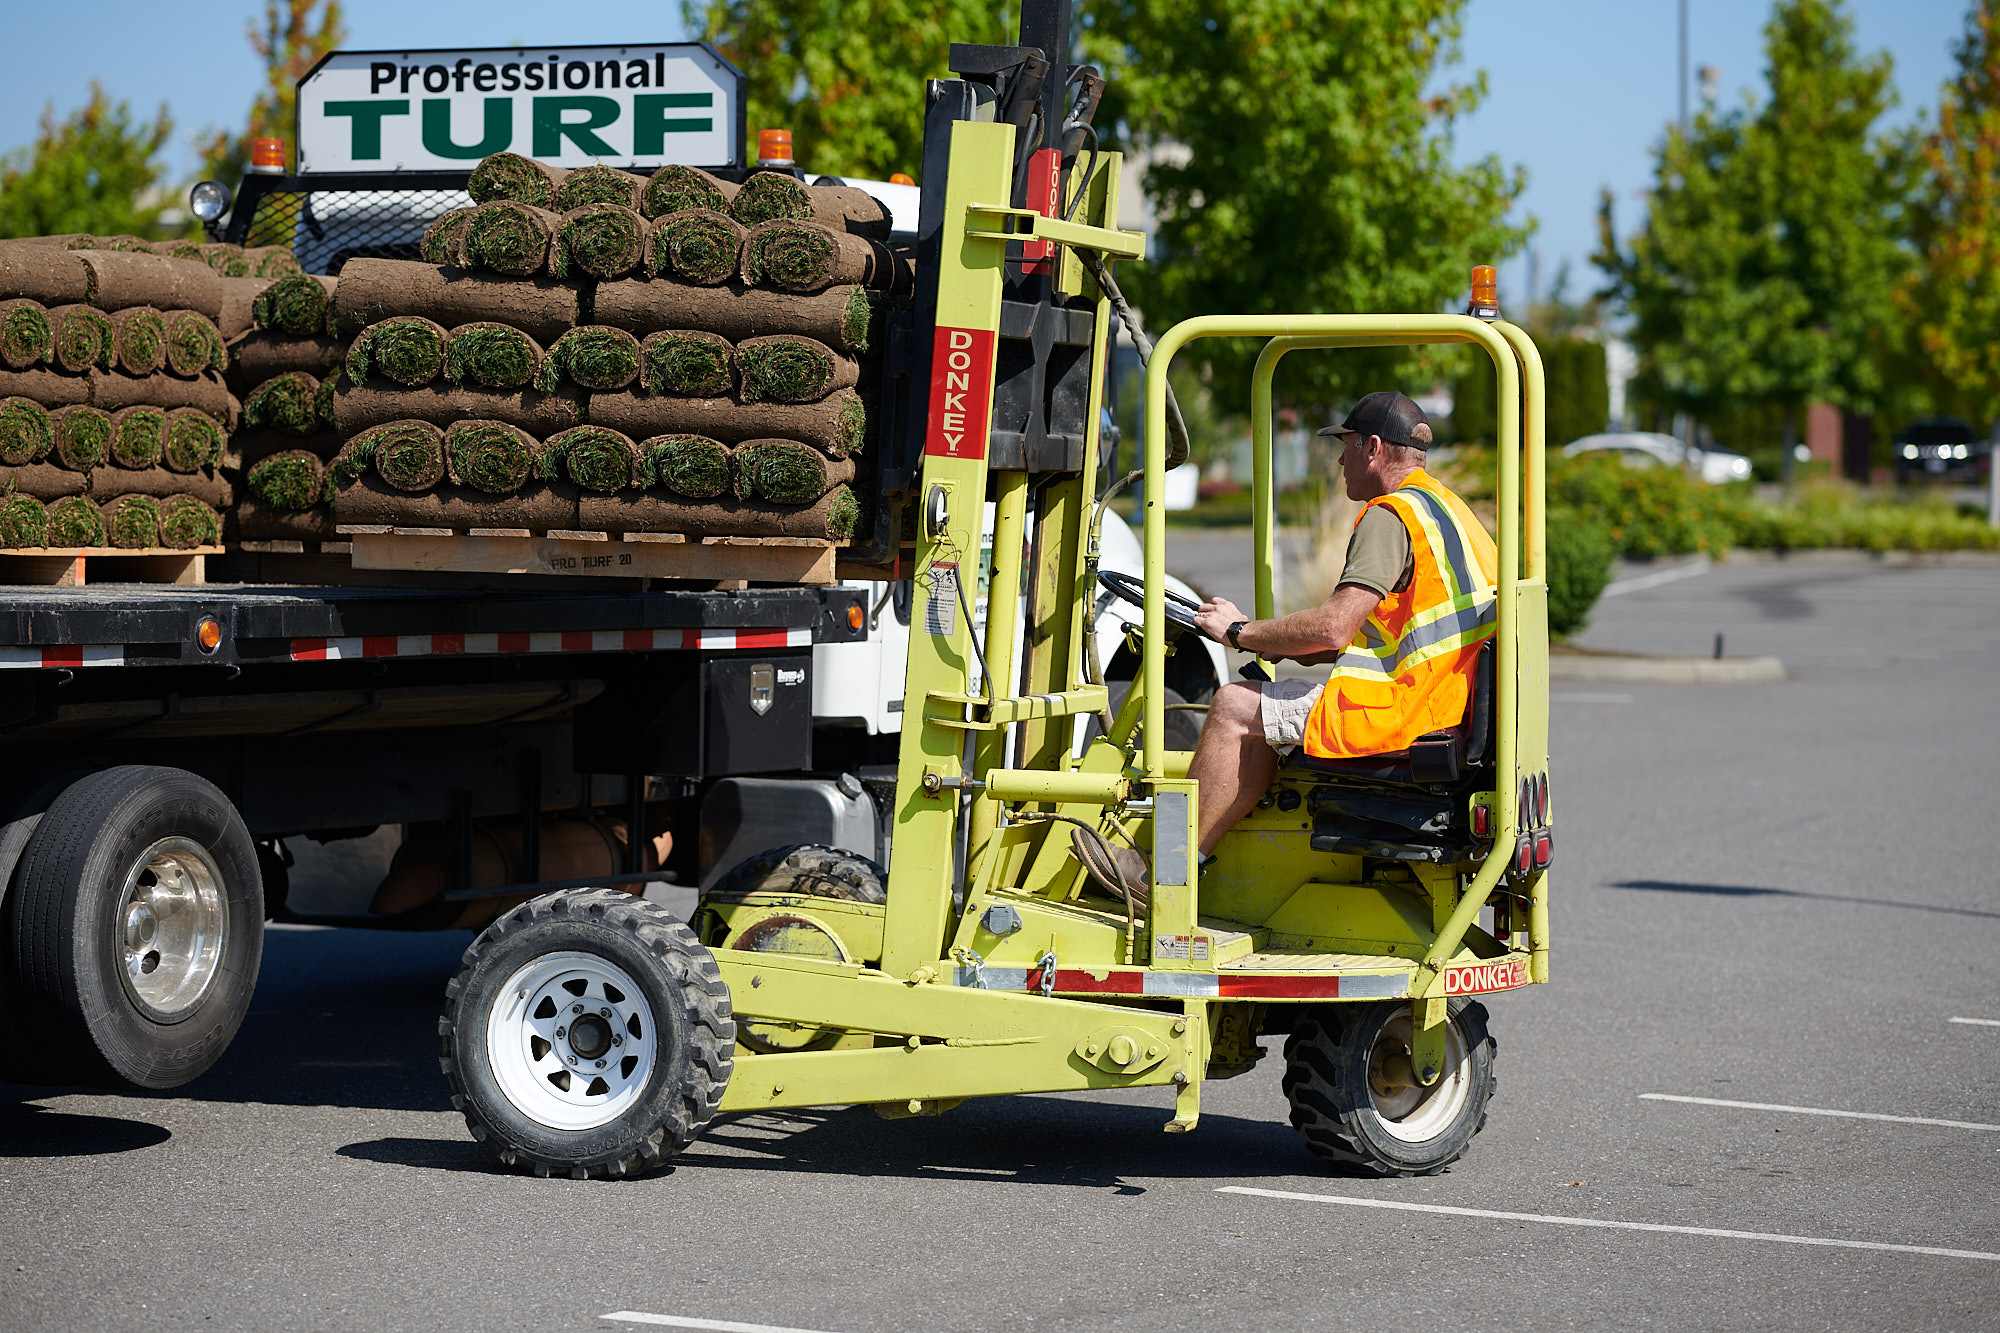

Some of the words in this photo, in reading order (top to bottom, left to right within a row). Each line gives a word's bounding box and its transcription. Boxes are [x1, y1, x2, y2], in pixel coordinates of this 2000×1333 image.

[370, 52, 666, 94] Professional
[323, 92, 714, 161] TURF
[1048, 152, 1060, 220] LOOK
[942, 330, 974, 452] DONKEY
[551, 557, 577, 570] PRO
[581, 555, 614, 569] TURF
[619, 553, 633, 566] 20
[1444, 963, 1515, 993] DONKEY
